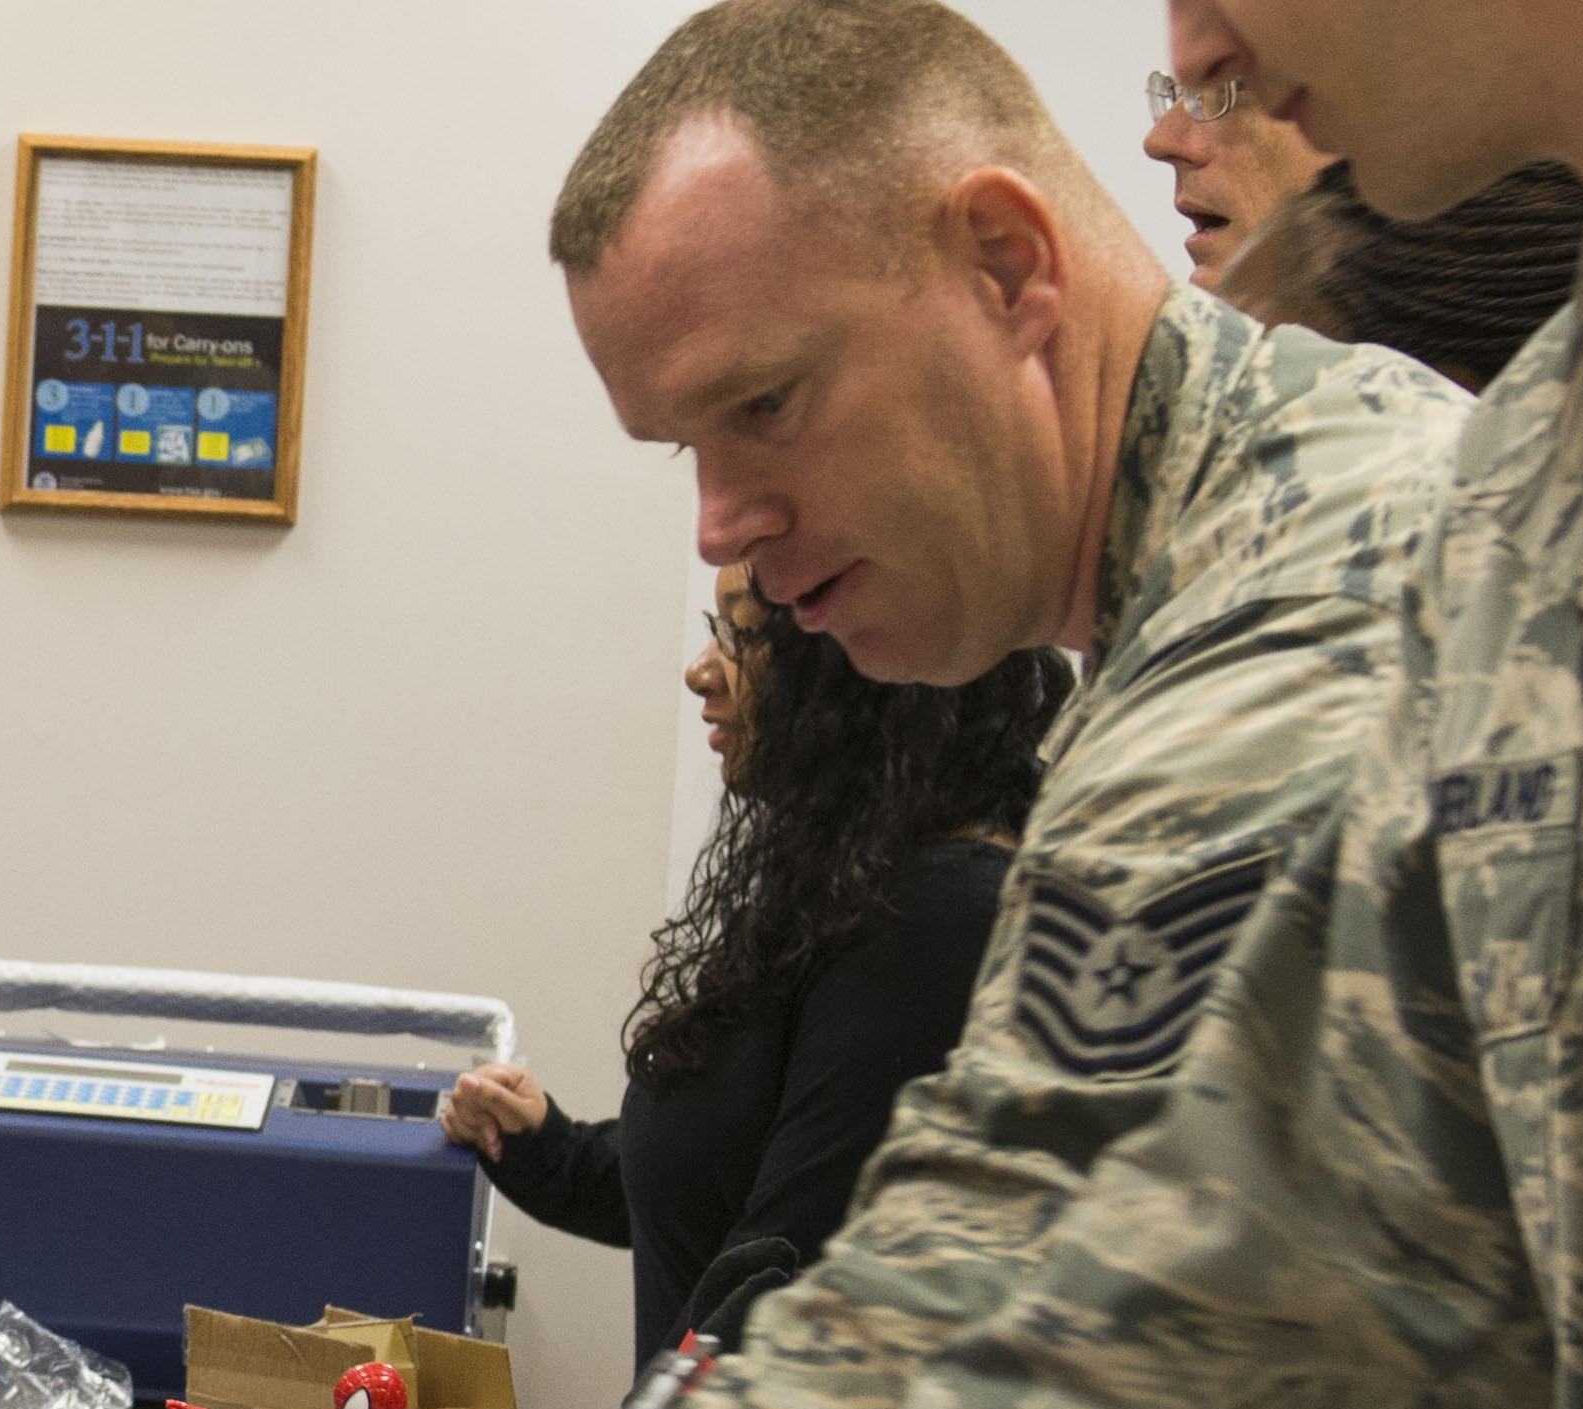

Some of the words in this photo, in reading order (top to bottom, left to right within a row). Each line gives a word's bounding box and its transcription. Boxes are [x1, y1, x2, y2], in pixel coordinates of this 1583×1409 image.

[65, 317, 144, 363] 3-1-1
[146, 332, 168, 350] for
[173, 333, 254, 355] Carry-ons
